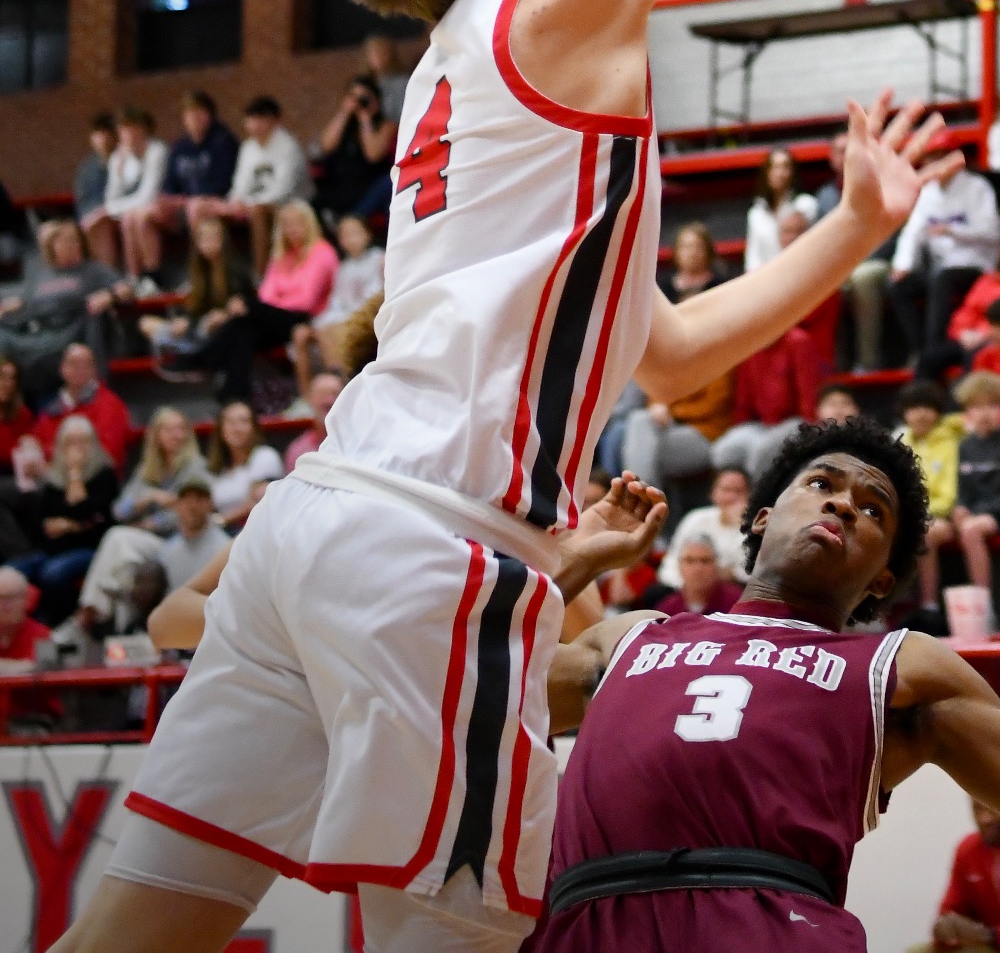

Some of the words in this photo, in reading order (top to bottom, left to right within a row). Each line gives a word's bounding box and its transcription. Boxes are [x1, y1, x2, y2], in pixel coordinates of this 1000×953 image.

[394, 74, 452, 223] 4
[625, 640, 727, 679] BIG
[735, 638, 847, 692] RED
[673, 674, 753, 743] 3
